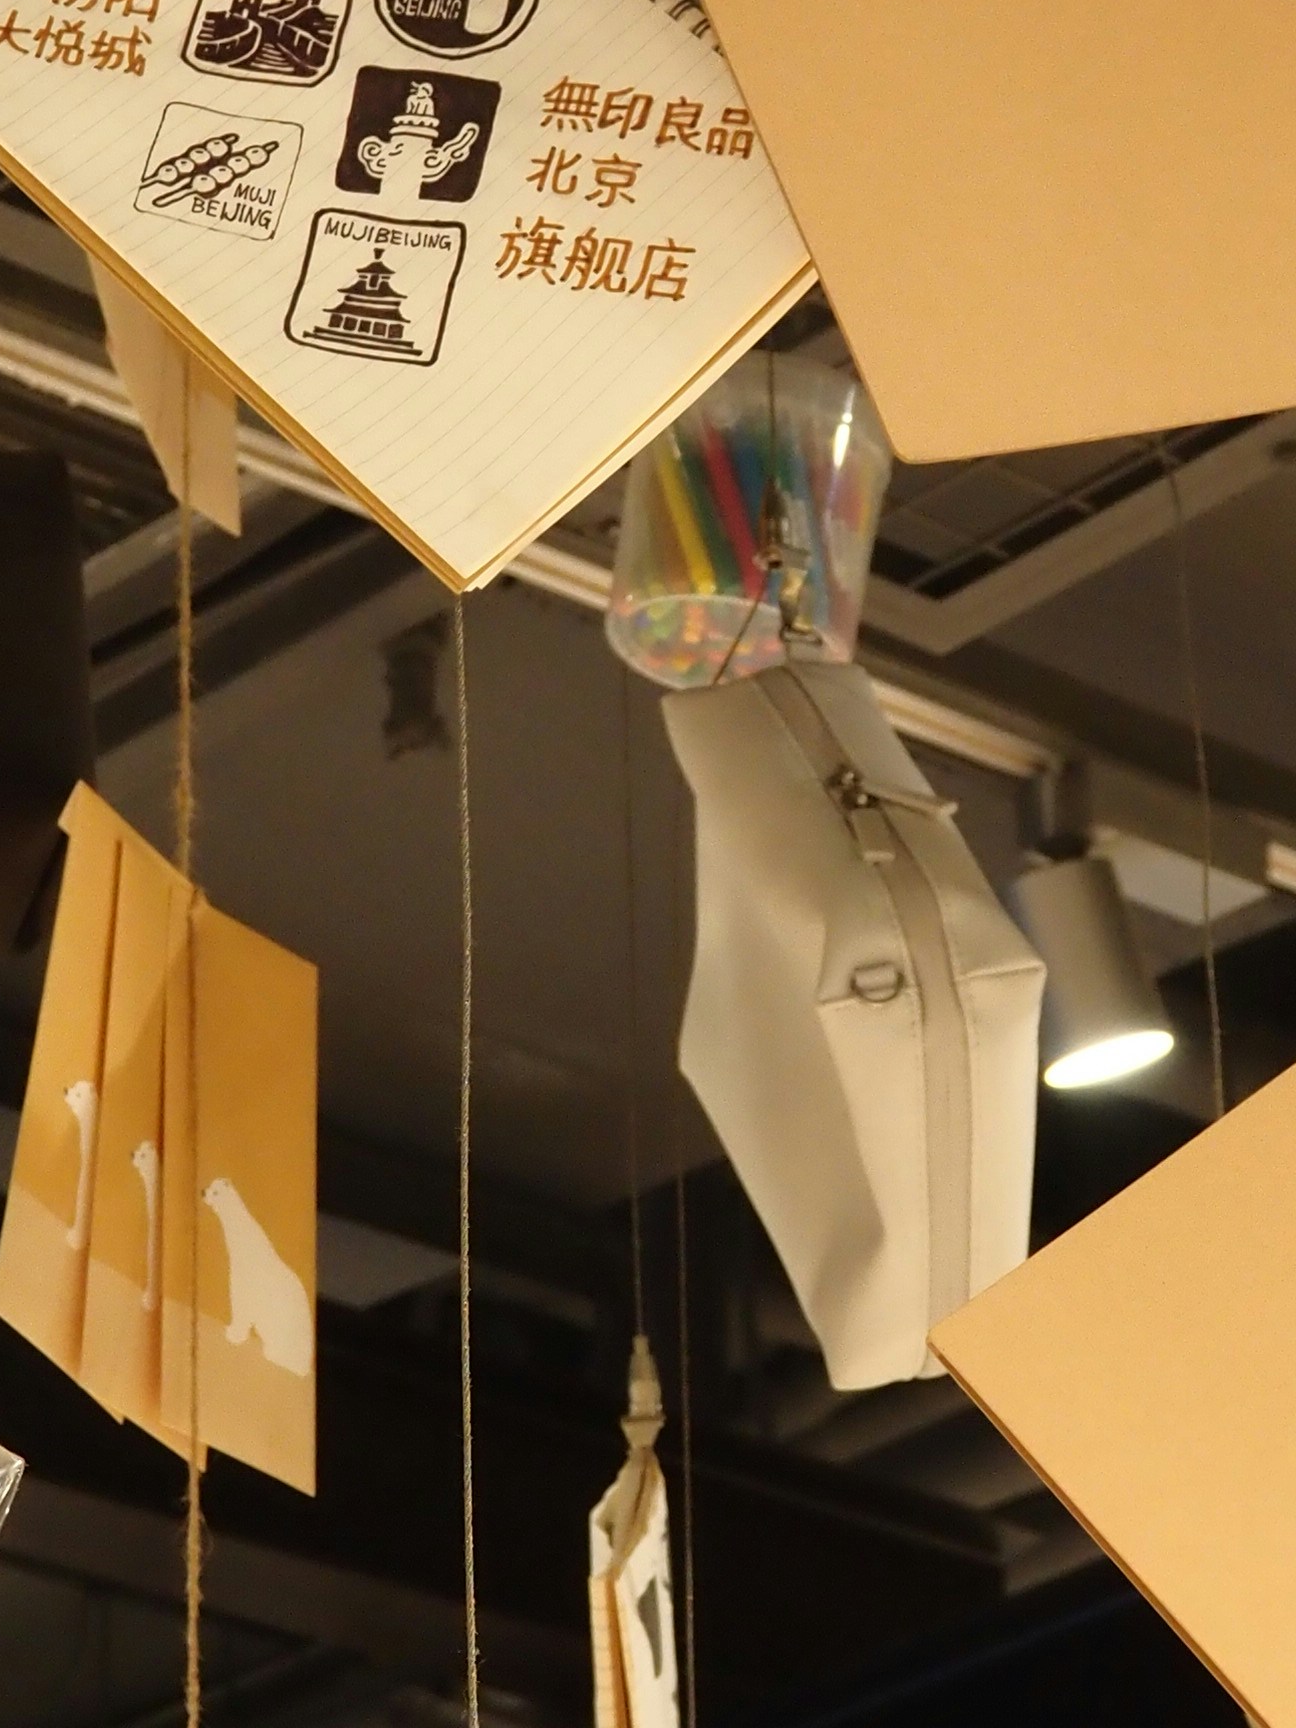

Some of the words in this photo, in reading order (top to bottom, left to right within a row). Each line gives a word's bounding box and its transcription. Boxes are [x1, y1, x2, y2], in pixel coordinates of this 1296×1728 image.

[540, 75, 754, 159] 無印良品
[233, 182, 277, 207] MUJI
[526, 146, 642, 208] 北京
[191, 196, 273, 230] BEIJING
[495, 216, 696, 301] 旗舰店
